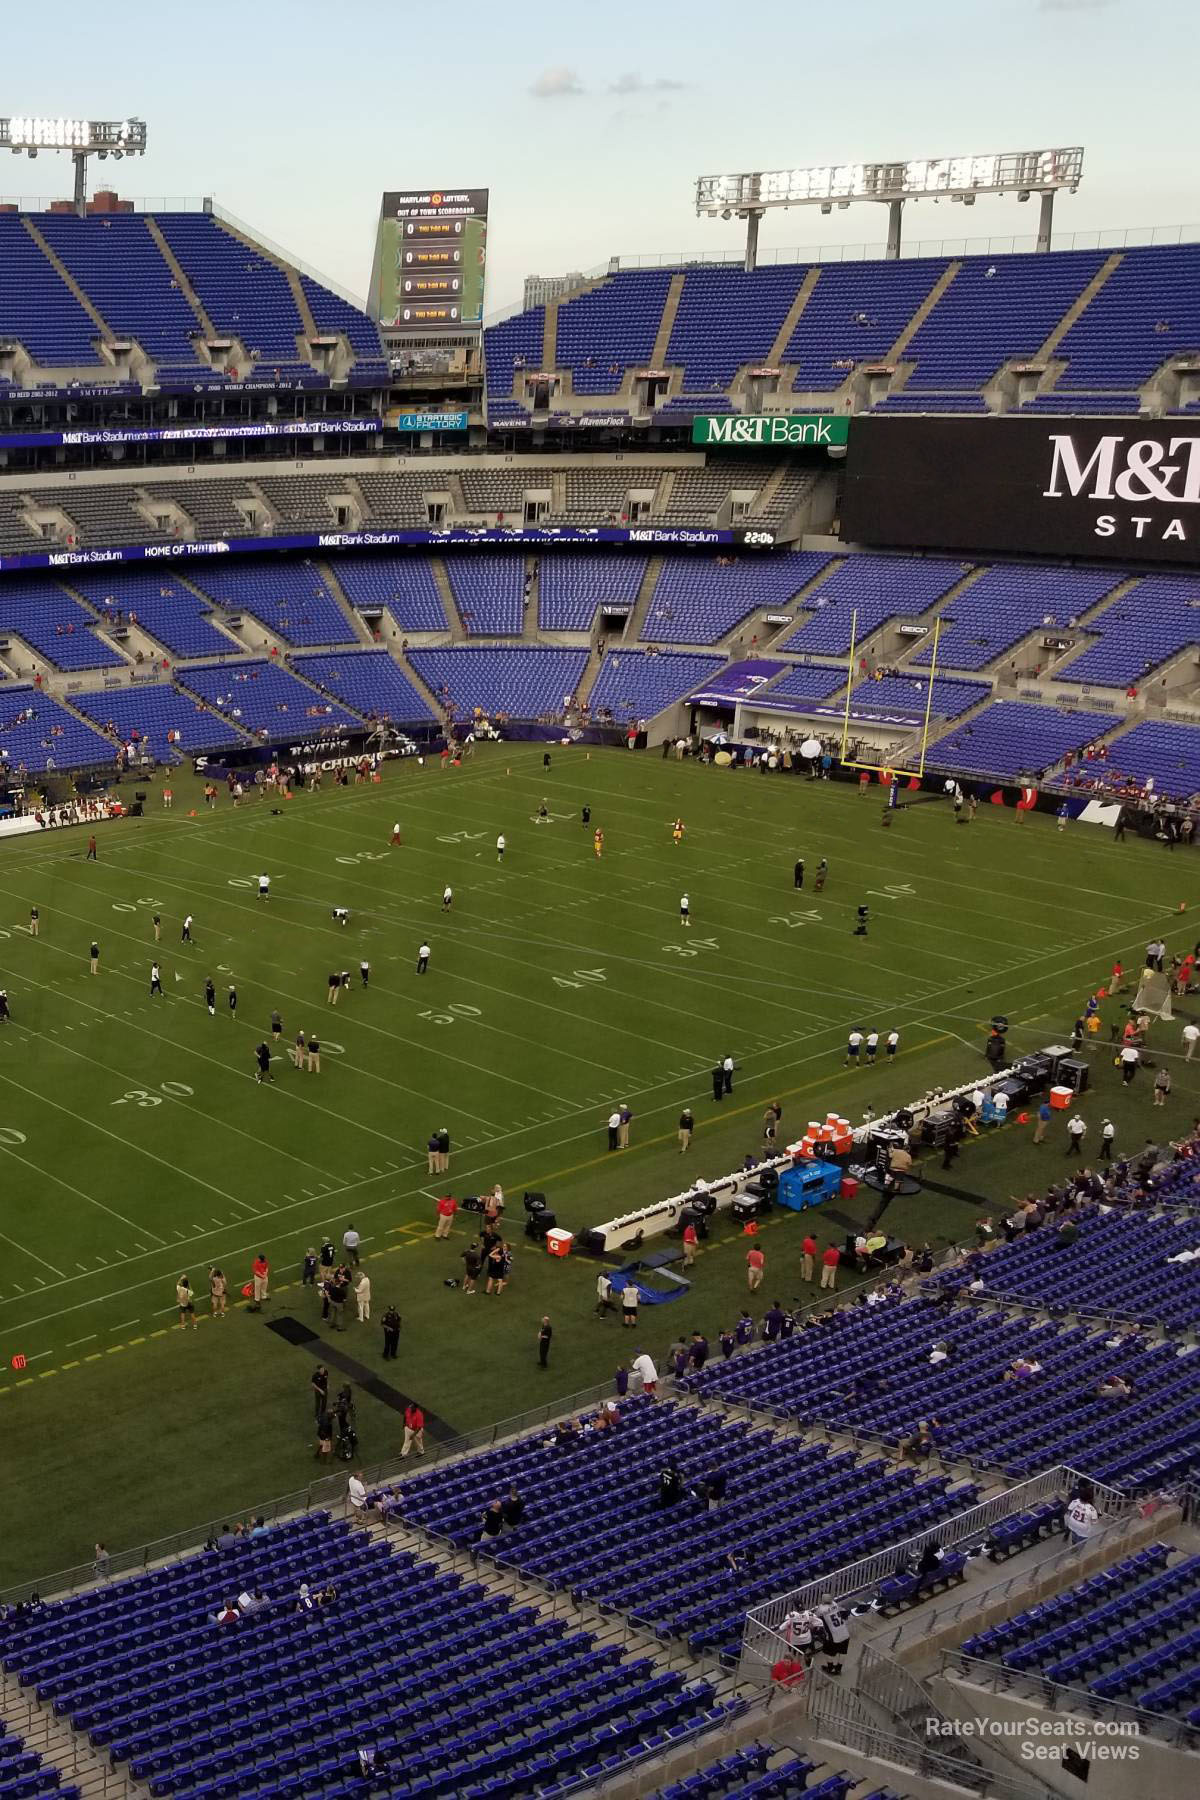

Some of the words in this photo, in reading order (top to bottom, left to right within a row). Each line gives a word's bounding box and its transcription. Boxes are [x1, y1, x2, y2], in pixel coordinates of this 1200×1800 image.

[400, 196, 431, 204] MARYLAND
[438, 207, 475, 215] SCOREBOARD
[407, 224, 414, 234] 0
[455, 222, 461, 233] 0
[406, 252, 412, 263] 0
[453, 250, 460, 261] 0
[405, 280, 412, 291] 0
[452, 279, 459, 289] 0
[404, 309, 411, 320] 0
[451, 307, 457, 318] 0
[416, 413, 462, 422] STRATEGIC
[580, 417, 624, 426] #RavensFlock
[320, 423, 342, 432] Bank
[342, 422, 376, 431] Stadium
[416, 420, 461, 429] FACTORY
[706, 418, 770, 442] M&T
[771, 417, 832, 443] Bank
[62, 432, 83, 444] M&T
[82, 432, 102, 443] Bank
[102, 431, 134, 441] Stadium
[1042, 435, 1200, 504] M&T
[1094, 515, 1186, 541] STA
[319, 535, 341, 546] M&T
[341, 535, 363, 545] Bank
[364, 533, 400, 544] Stadium
[629, 530, 655, 541] M&T
[655, 531, 679, 541] Bank
[679, 531, 718, 542] Stadium
[144, 547, 171, 557] HOME
[172, 545, 185, 554] OF
[49, 554, 71, 565] M&T
[70, 553, 90, 563] Bank
[90, 551, 122, 562] Stadium
[866, 883, 914, 899] 10
[769, 910, 821, 928] 20
[662, 939, 717, 958] 30
[551, 968, 604, 990] 40
[417, 1003, 482, 1026] 50
[124, 1080, 195, 1108] 30
[549, 1240, 559, 1251] G
[16, 1357, 25, 1368] 10
[792, 1622, 809, 1636] 52
